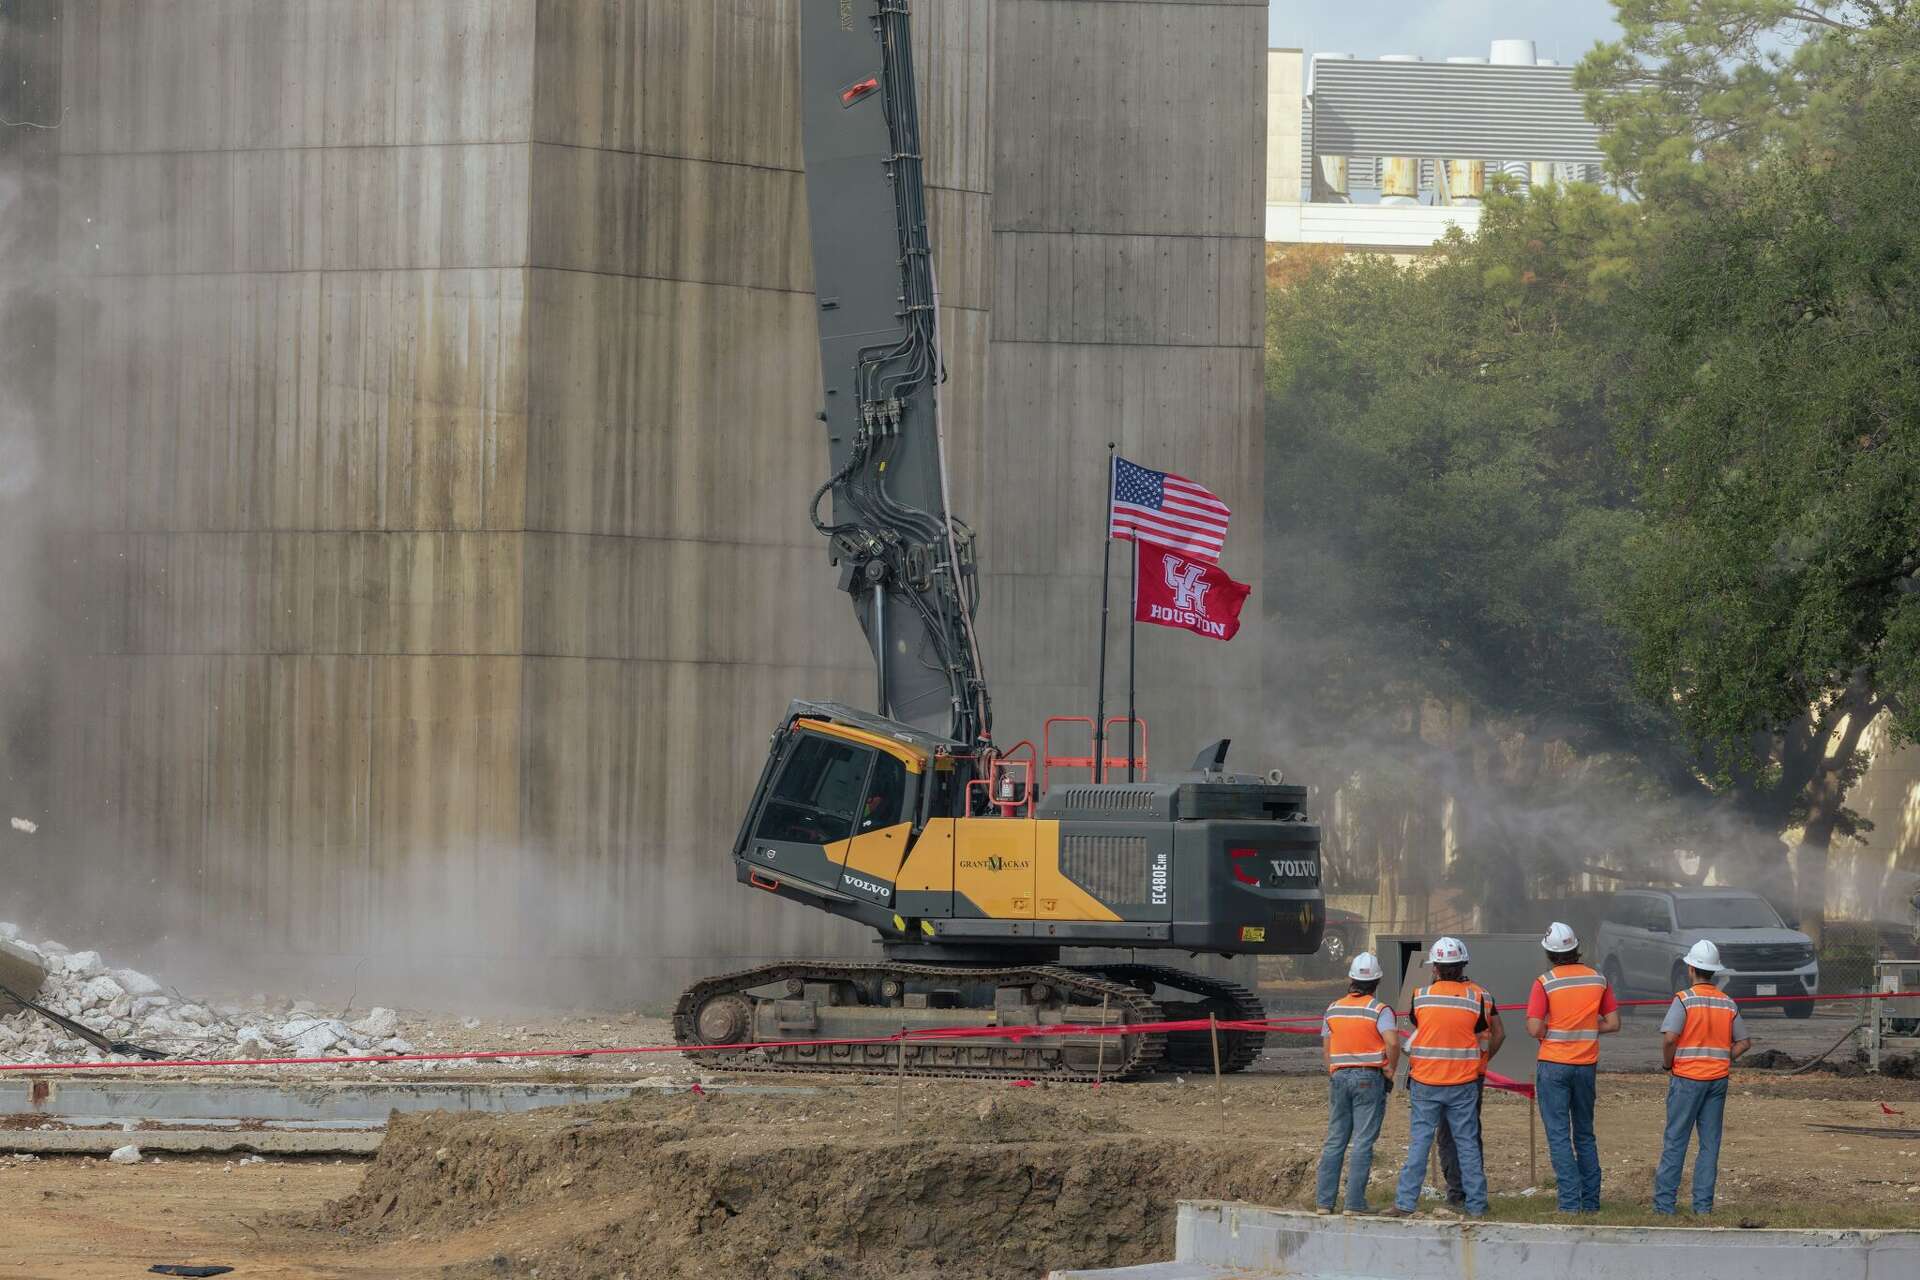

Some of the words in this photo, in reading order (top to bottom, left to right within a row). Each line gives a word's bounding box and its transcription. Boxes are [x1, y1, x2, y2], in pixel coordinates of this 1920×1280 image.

[1163, 554, 1210, 616] UH
[1151, 604, 1225, 636] HOUSTON
[959, 860, 988, 869] GRANT
[988, 856, 1030, 871] MACKAY
[1270, 860, 1317, 877] VOLVO
[843, 874, 890, 897] VOLVO
